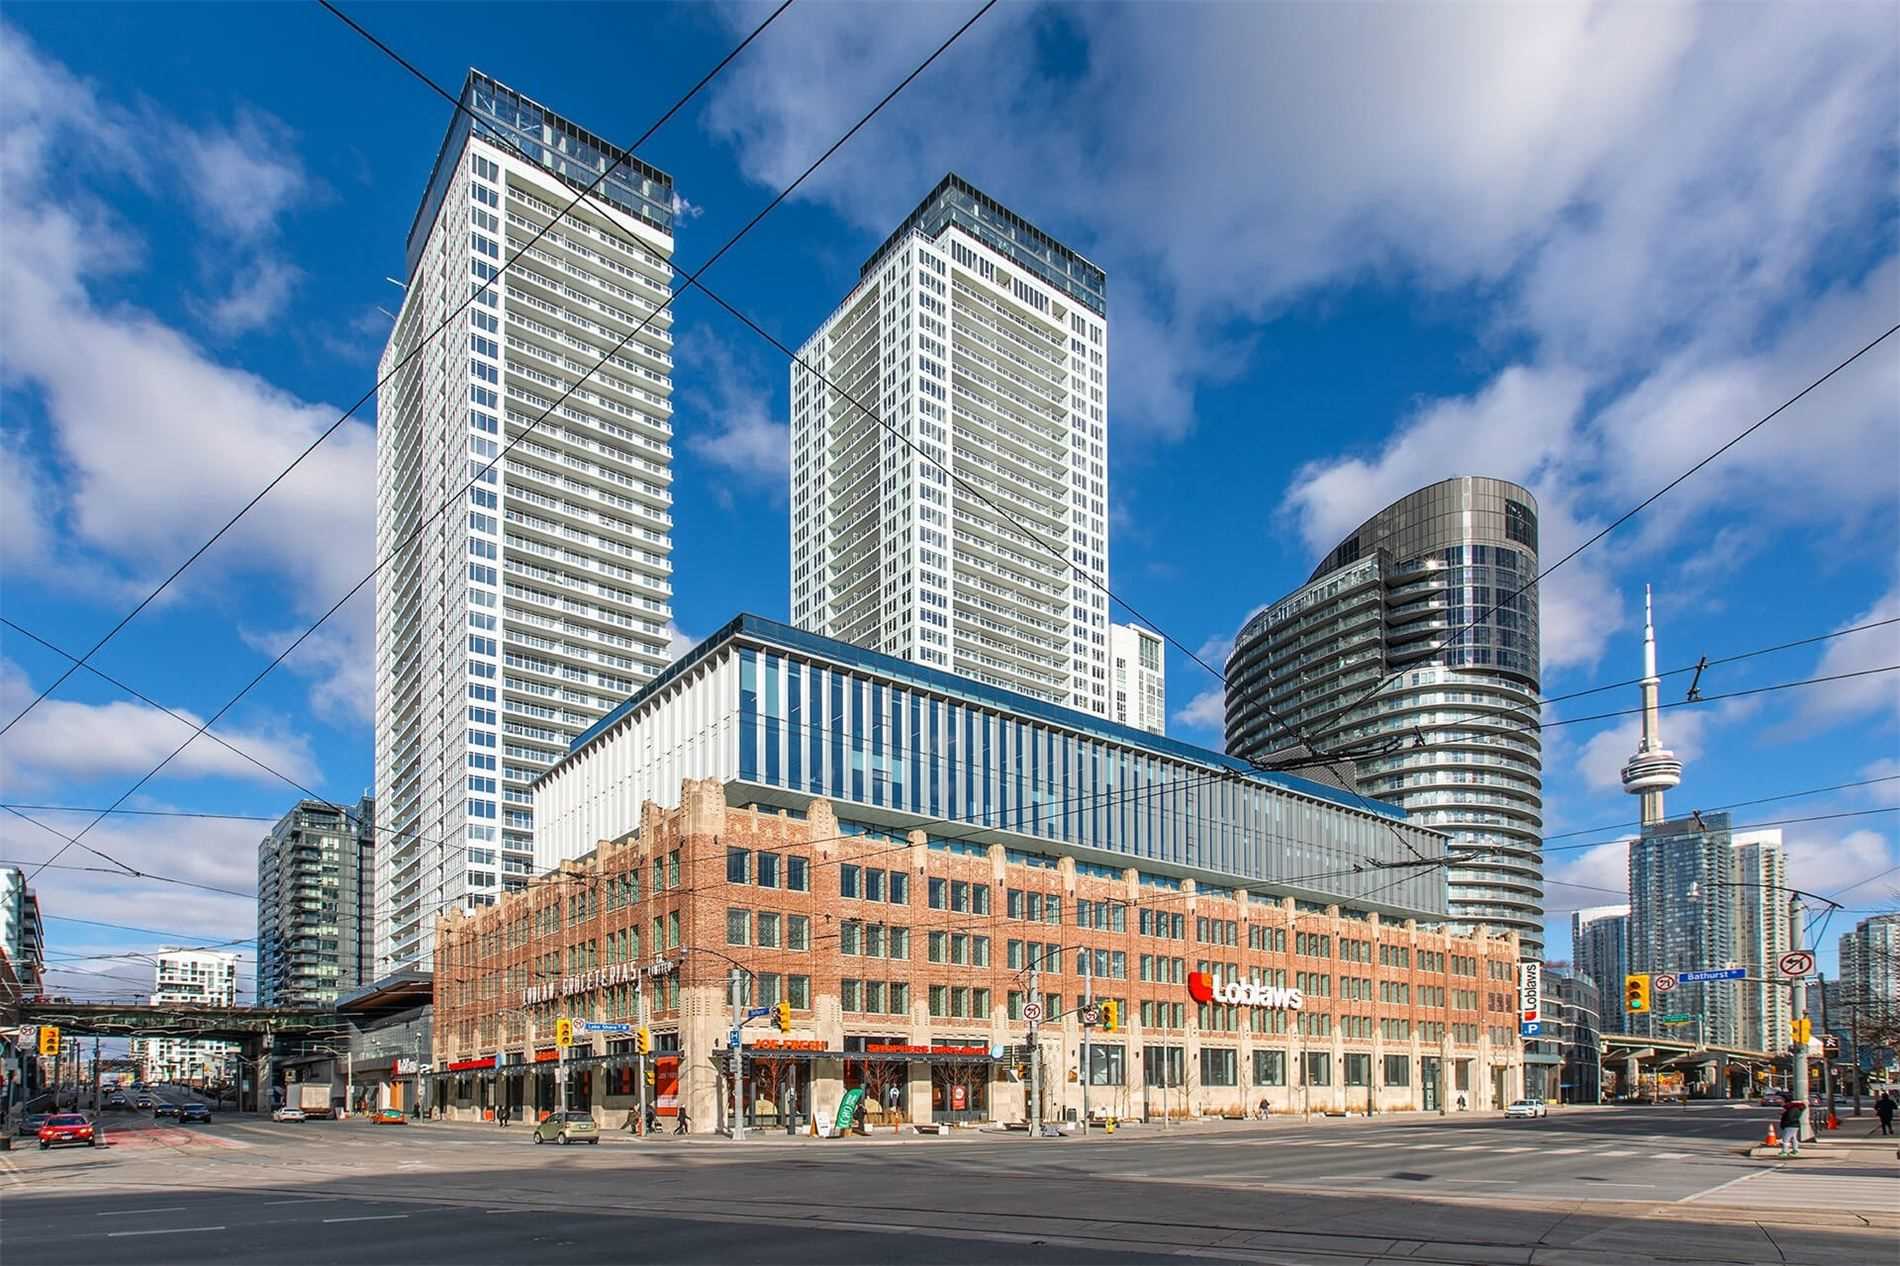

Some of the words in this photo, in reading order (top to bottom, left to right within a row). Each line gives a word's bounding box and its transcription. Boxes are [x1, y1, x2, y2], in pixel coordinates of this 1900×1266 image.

[562, 961, 637, 997] GROCETERIAS
[1525, 964, 1537, 1010] Loblaws
[1688, 971, 1729, 980] Bathurst
[1213, 974, 1304, 1009] Loblaws
[1528, 1024, 1538, 1034] P
[752, 1039, 777, 1050] JOE
[783, 1040, 825, 1052] FRESH
